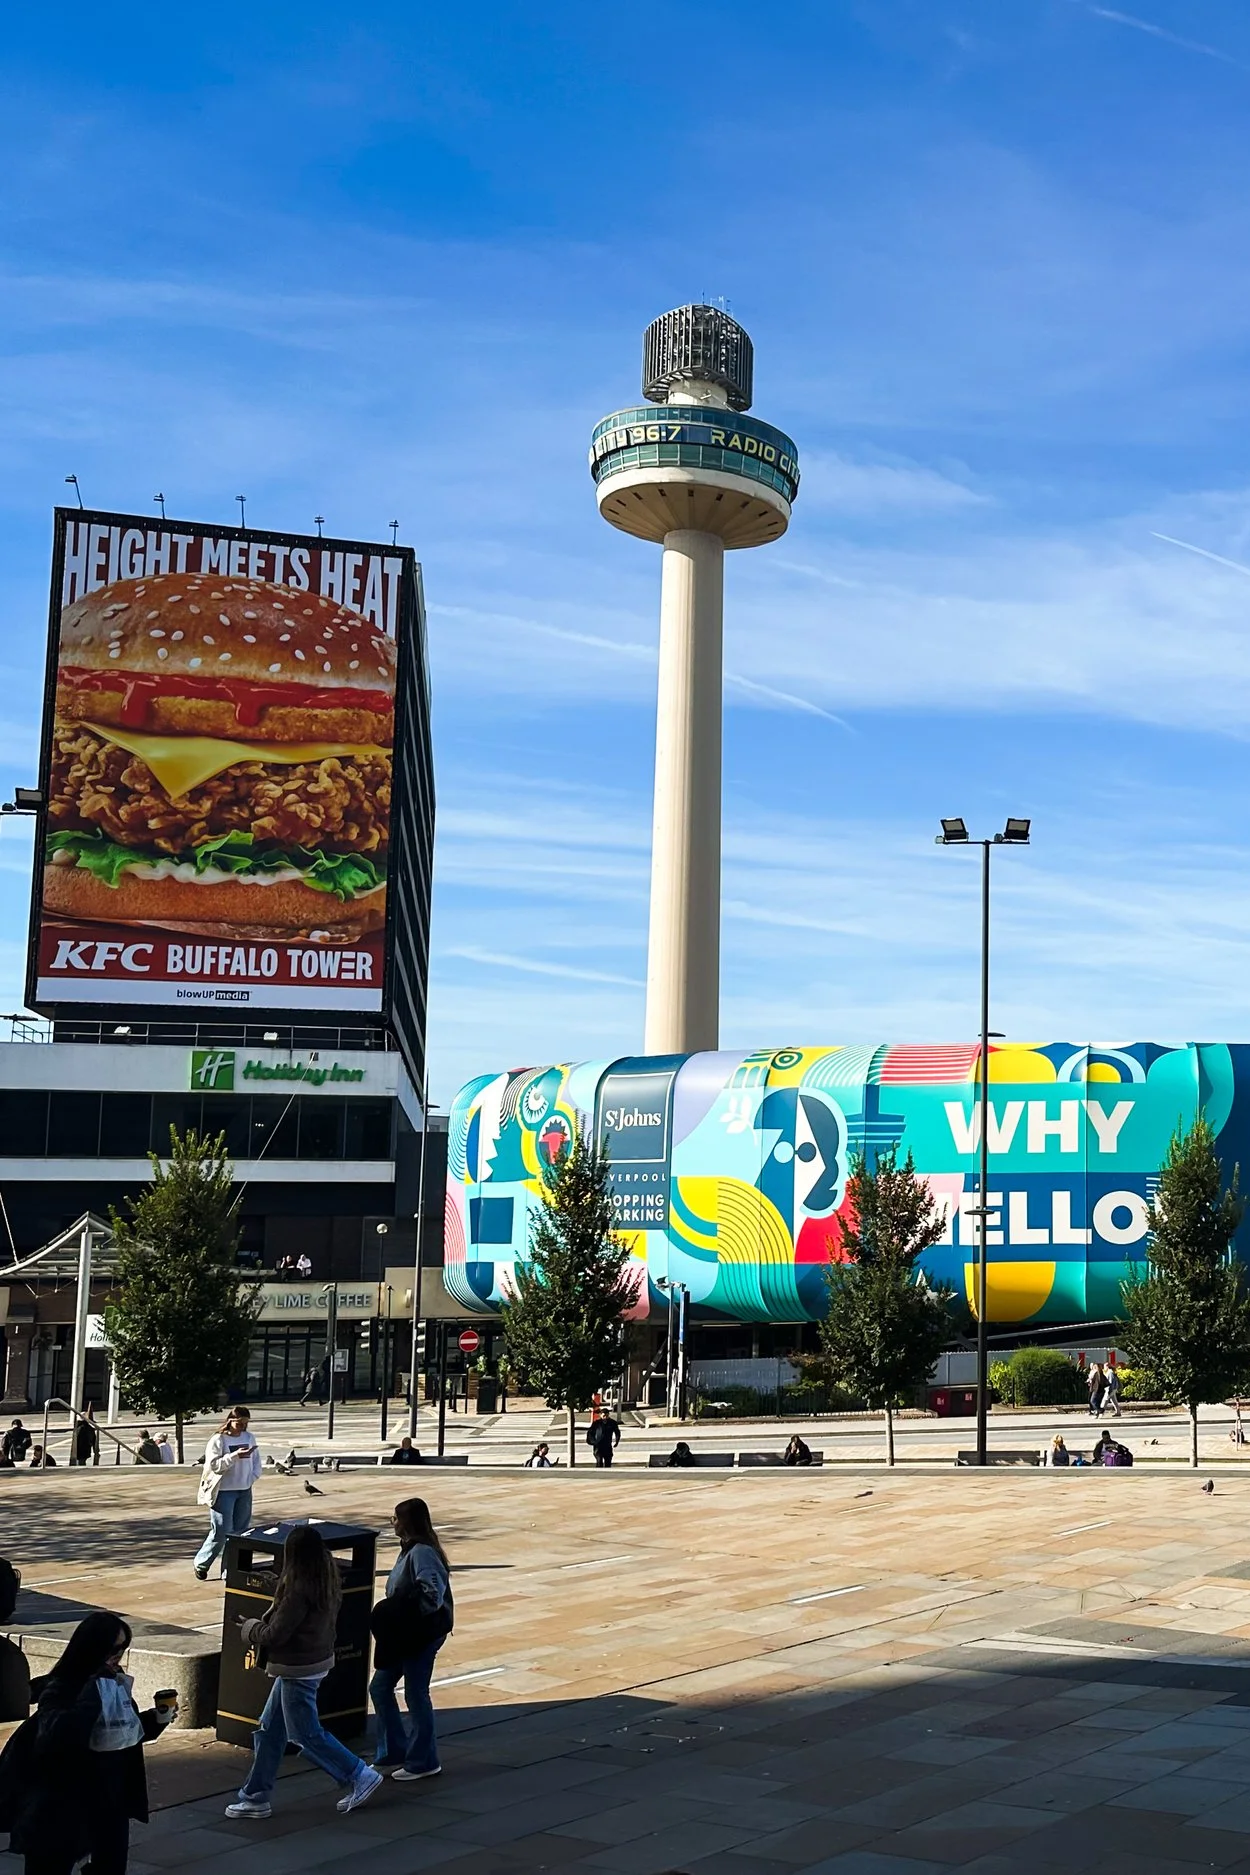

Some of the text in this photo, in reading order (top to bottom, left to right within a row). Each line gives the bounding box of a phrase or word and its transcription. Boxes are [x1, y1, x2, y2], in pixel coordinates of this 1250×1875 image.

[711, 429, 776, 462] RADIO
[61, 520, 403, 640] HEIGHT MEETS HEAT
[50, 940, 373, 980] KFC BUFFALO TOWER
[242, 1060, 365, 1086] Holiday Inn
[944, 1100, 1136, 1154] WHY
[609, 1172, 666, 1182] VERPOOL
[603, 1194, 665, 1208] HOPPING
[607, 1209, 665, 1222] ARKING
[275, 1294, 310, 1308] LIME
